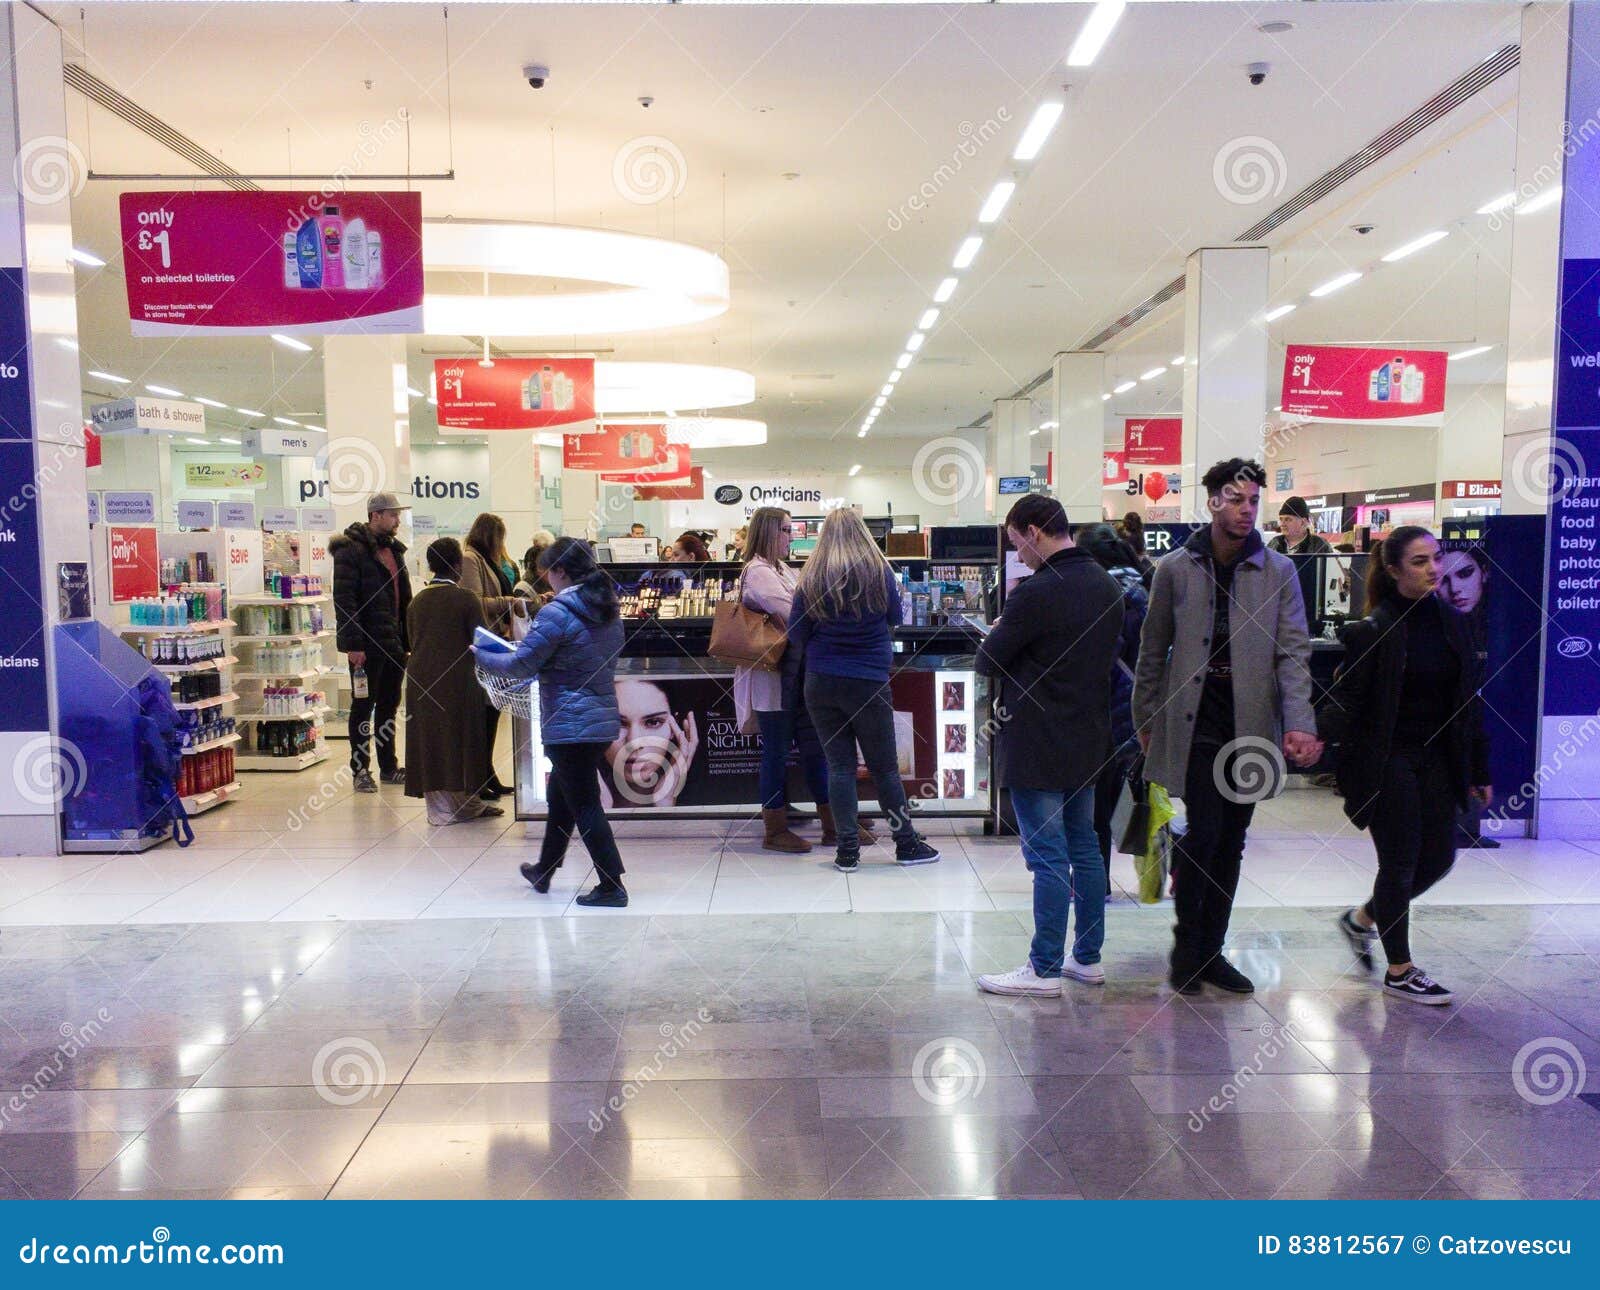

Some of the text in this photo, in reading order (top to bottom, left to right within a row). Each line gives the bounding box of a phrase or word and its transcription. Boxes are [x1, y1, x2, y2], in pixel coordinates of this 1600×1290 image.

[137, 208, 174, 227] only
[138, 230, 171, 268] £1
[141, 273, 235, 283] on selected toiletries
[169, 311, 186, 319] today
[1294, 354, 1315, 366] only
[0, 363, 19, 378] to
[444, 367, 464, 377] only
[1292, 365, 1311, 387] £1
[444, 378, 462, 399] £1
[139, 406, 202, 423] bath & shower
[1130, 424, 1145, 433] only
[282, 438, 307, 448] men's
[196, 466, 211, 475] 1/2
[750, 486, 821, 502] Opticians
[107, 500, 143, 508] shampoos
[107, 507, 151, 515] conditioners
[1560, 516, 1595, 528] food
[1560, 536, 1596, 551] baby
[113, 540, 131, 562] only
[231, 549, 248, 564] save
[312, 547, 325, 561] save
[1559, 556, 1600, 571] photo
[707, 735, 752, 748] NIGHT
